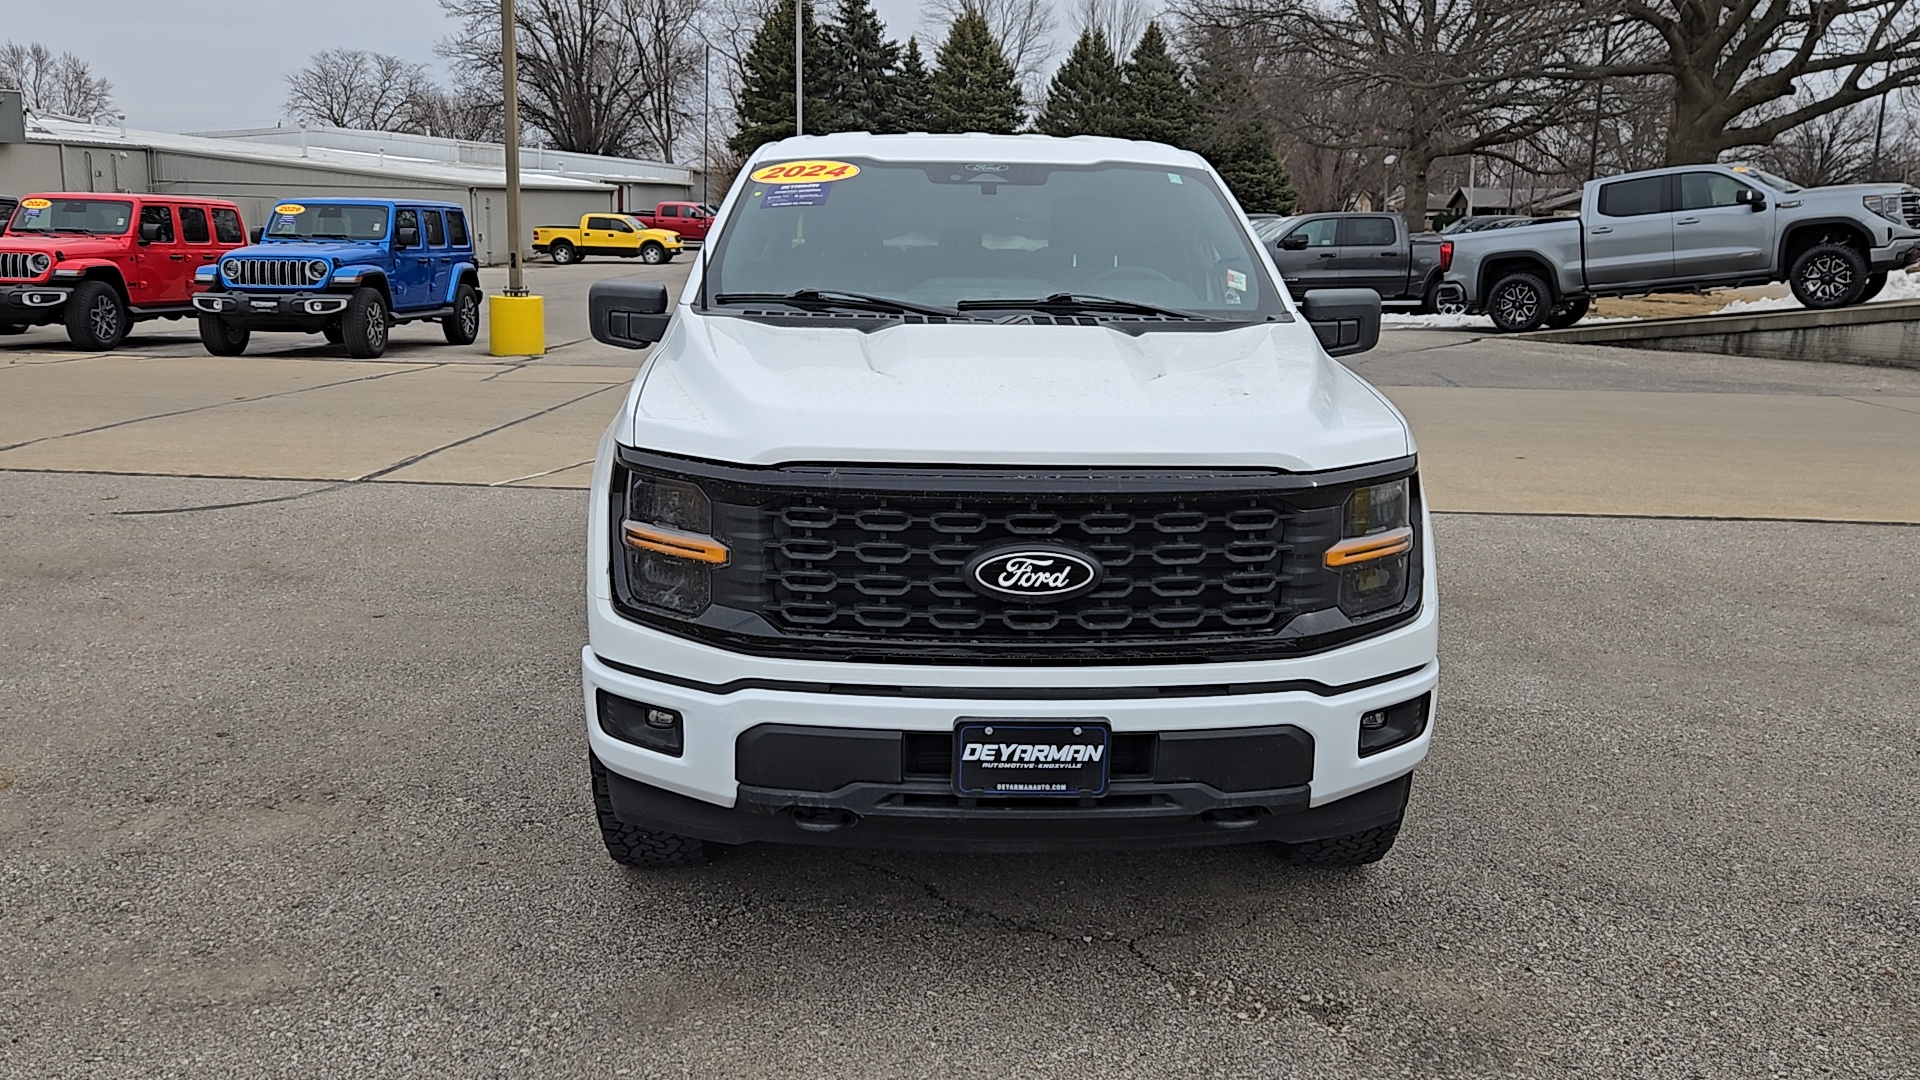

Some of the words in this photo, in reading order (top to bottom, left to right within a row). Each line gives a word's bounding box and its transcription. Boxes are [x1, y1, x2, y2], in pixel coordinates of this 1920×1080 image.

[760, 165, 851, 180] 2024
[998, 558, 1072, 588] Ford
[962, 743, 1105, 762] DEYARMAN
[996, 783, 1067, 791] DEYARMANAUTO.COM
